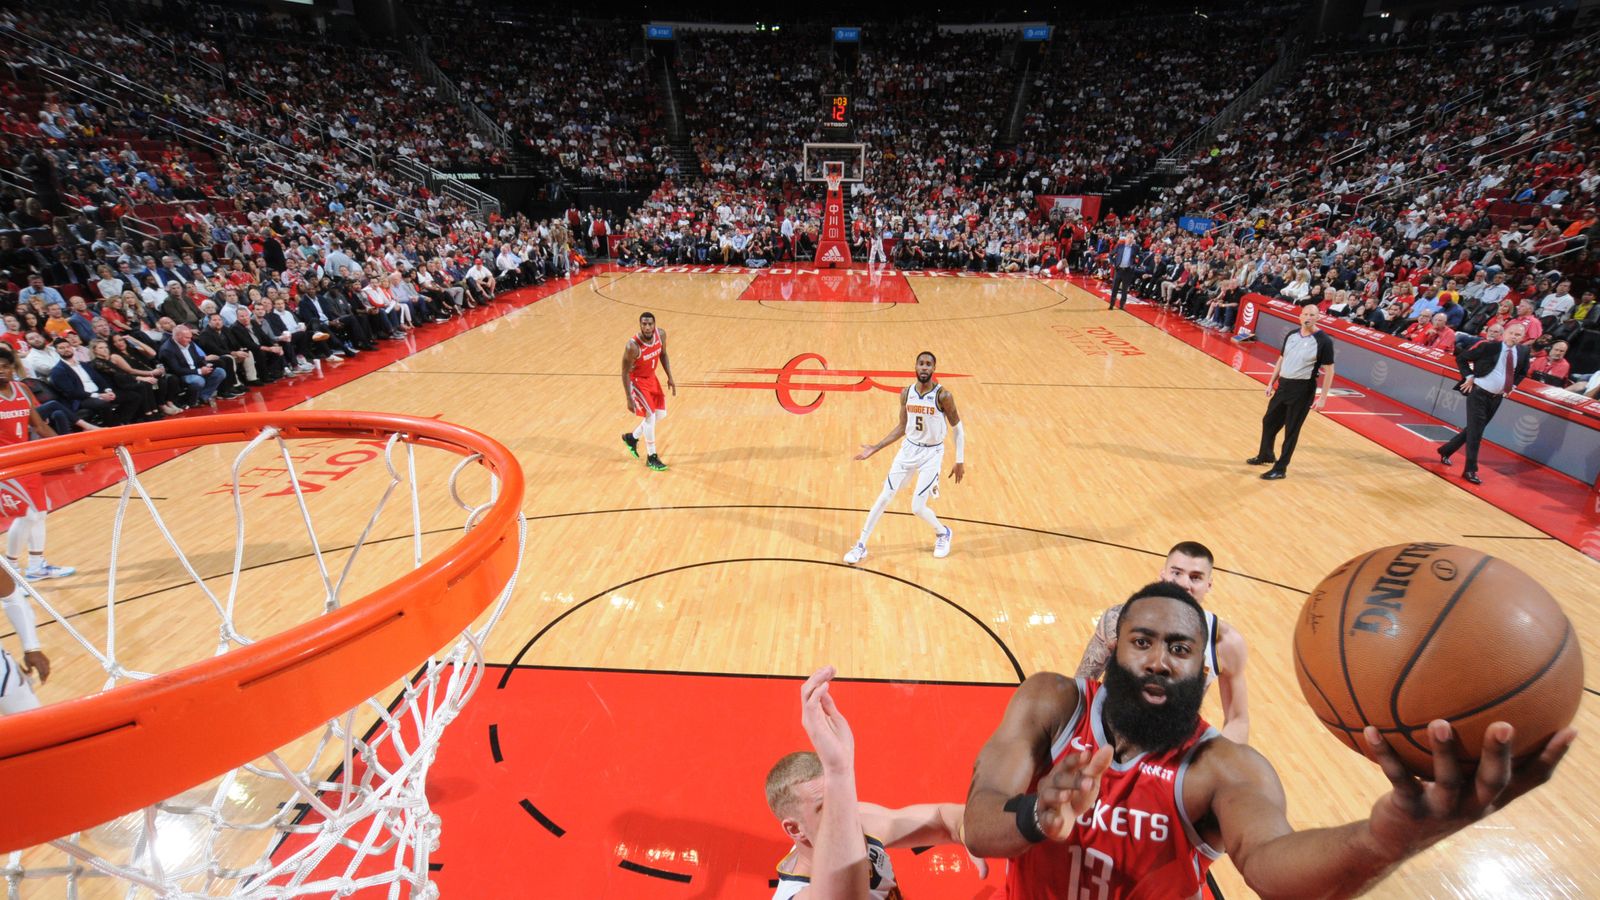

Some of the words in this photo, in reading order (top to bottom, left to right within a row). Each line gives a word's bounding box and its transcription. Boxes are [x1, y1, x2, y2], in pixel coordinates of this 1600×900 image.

[832, 105, 845, 121] 12
[1194, 221, 1208, 231] AT&T
[634, 266, 820, 275] HOUSTON
[1050, 325, 1109, 356] CENTER
[1081, 326, 1147, 357] TOYOTA
[906, 404, 935, 415] NUGGETS
[15, 422, 23, 439] 4
[915, 415, 924, 432] 5
[1067, 845, 1114, 900] 13
